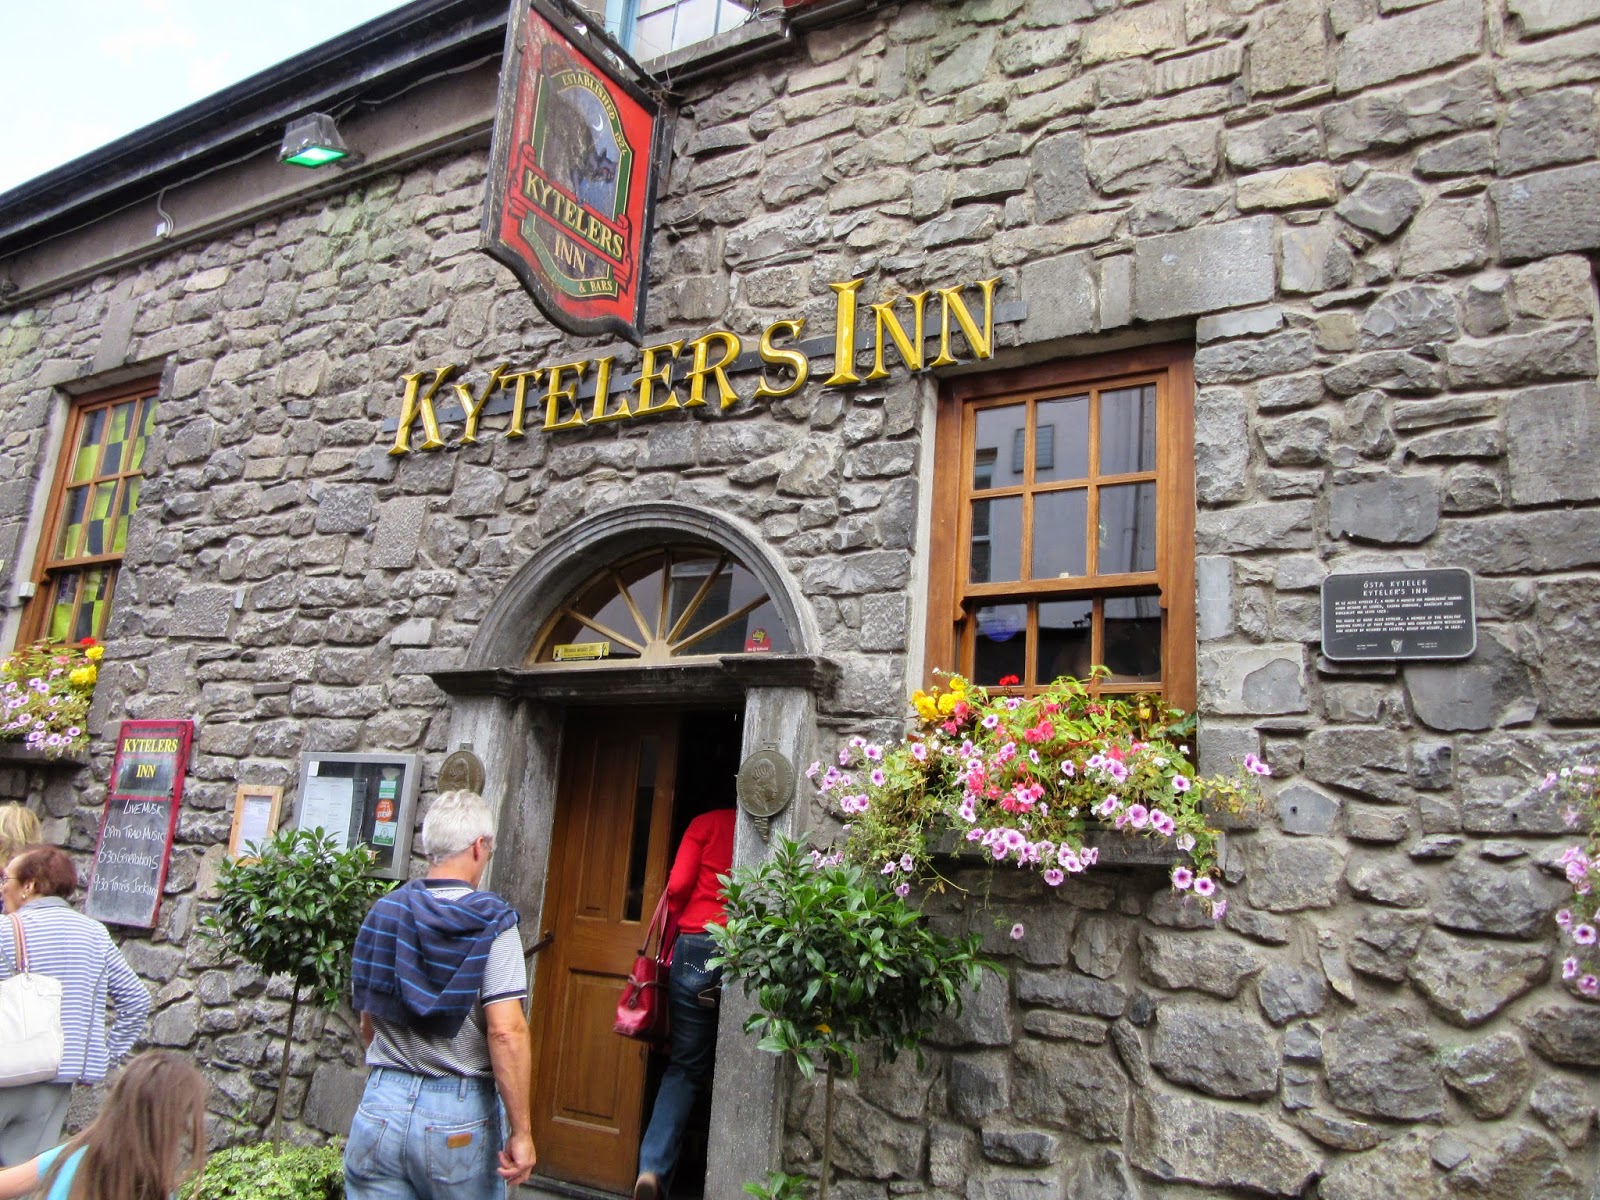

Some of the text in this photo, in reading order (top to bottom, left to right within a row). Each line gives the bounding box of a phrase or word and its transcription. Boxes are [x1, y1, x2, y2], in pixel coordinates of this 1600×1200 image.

[562, 73, 615, 120] ESTABLISHED
[525, 169, 624, 260] KYTELERS
[554, 233, 587, 274] INN
[590, 280, 613, 292] BARS
[388, 276, 1002, 457] KYTELERS INN
[1390, 579, 1427, 588] KYTELER
[1363, 587, 1429, 597] KYTELER'S INN
[123, 738, 179, 753] KYTELERS
[136, 764, 156, 778] INN
